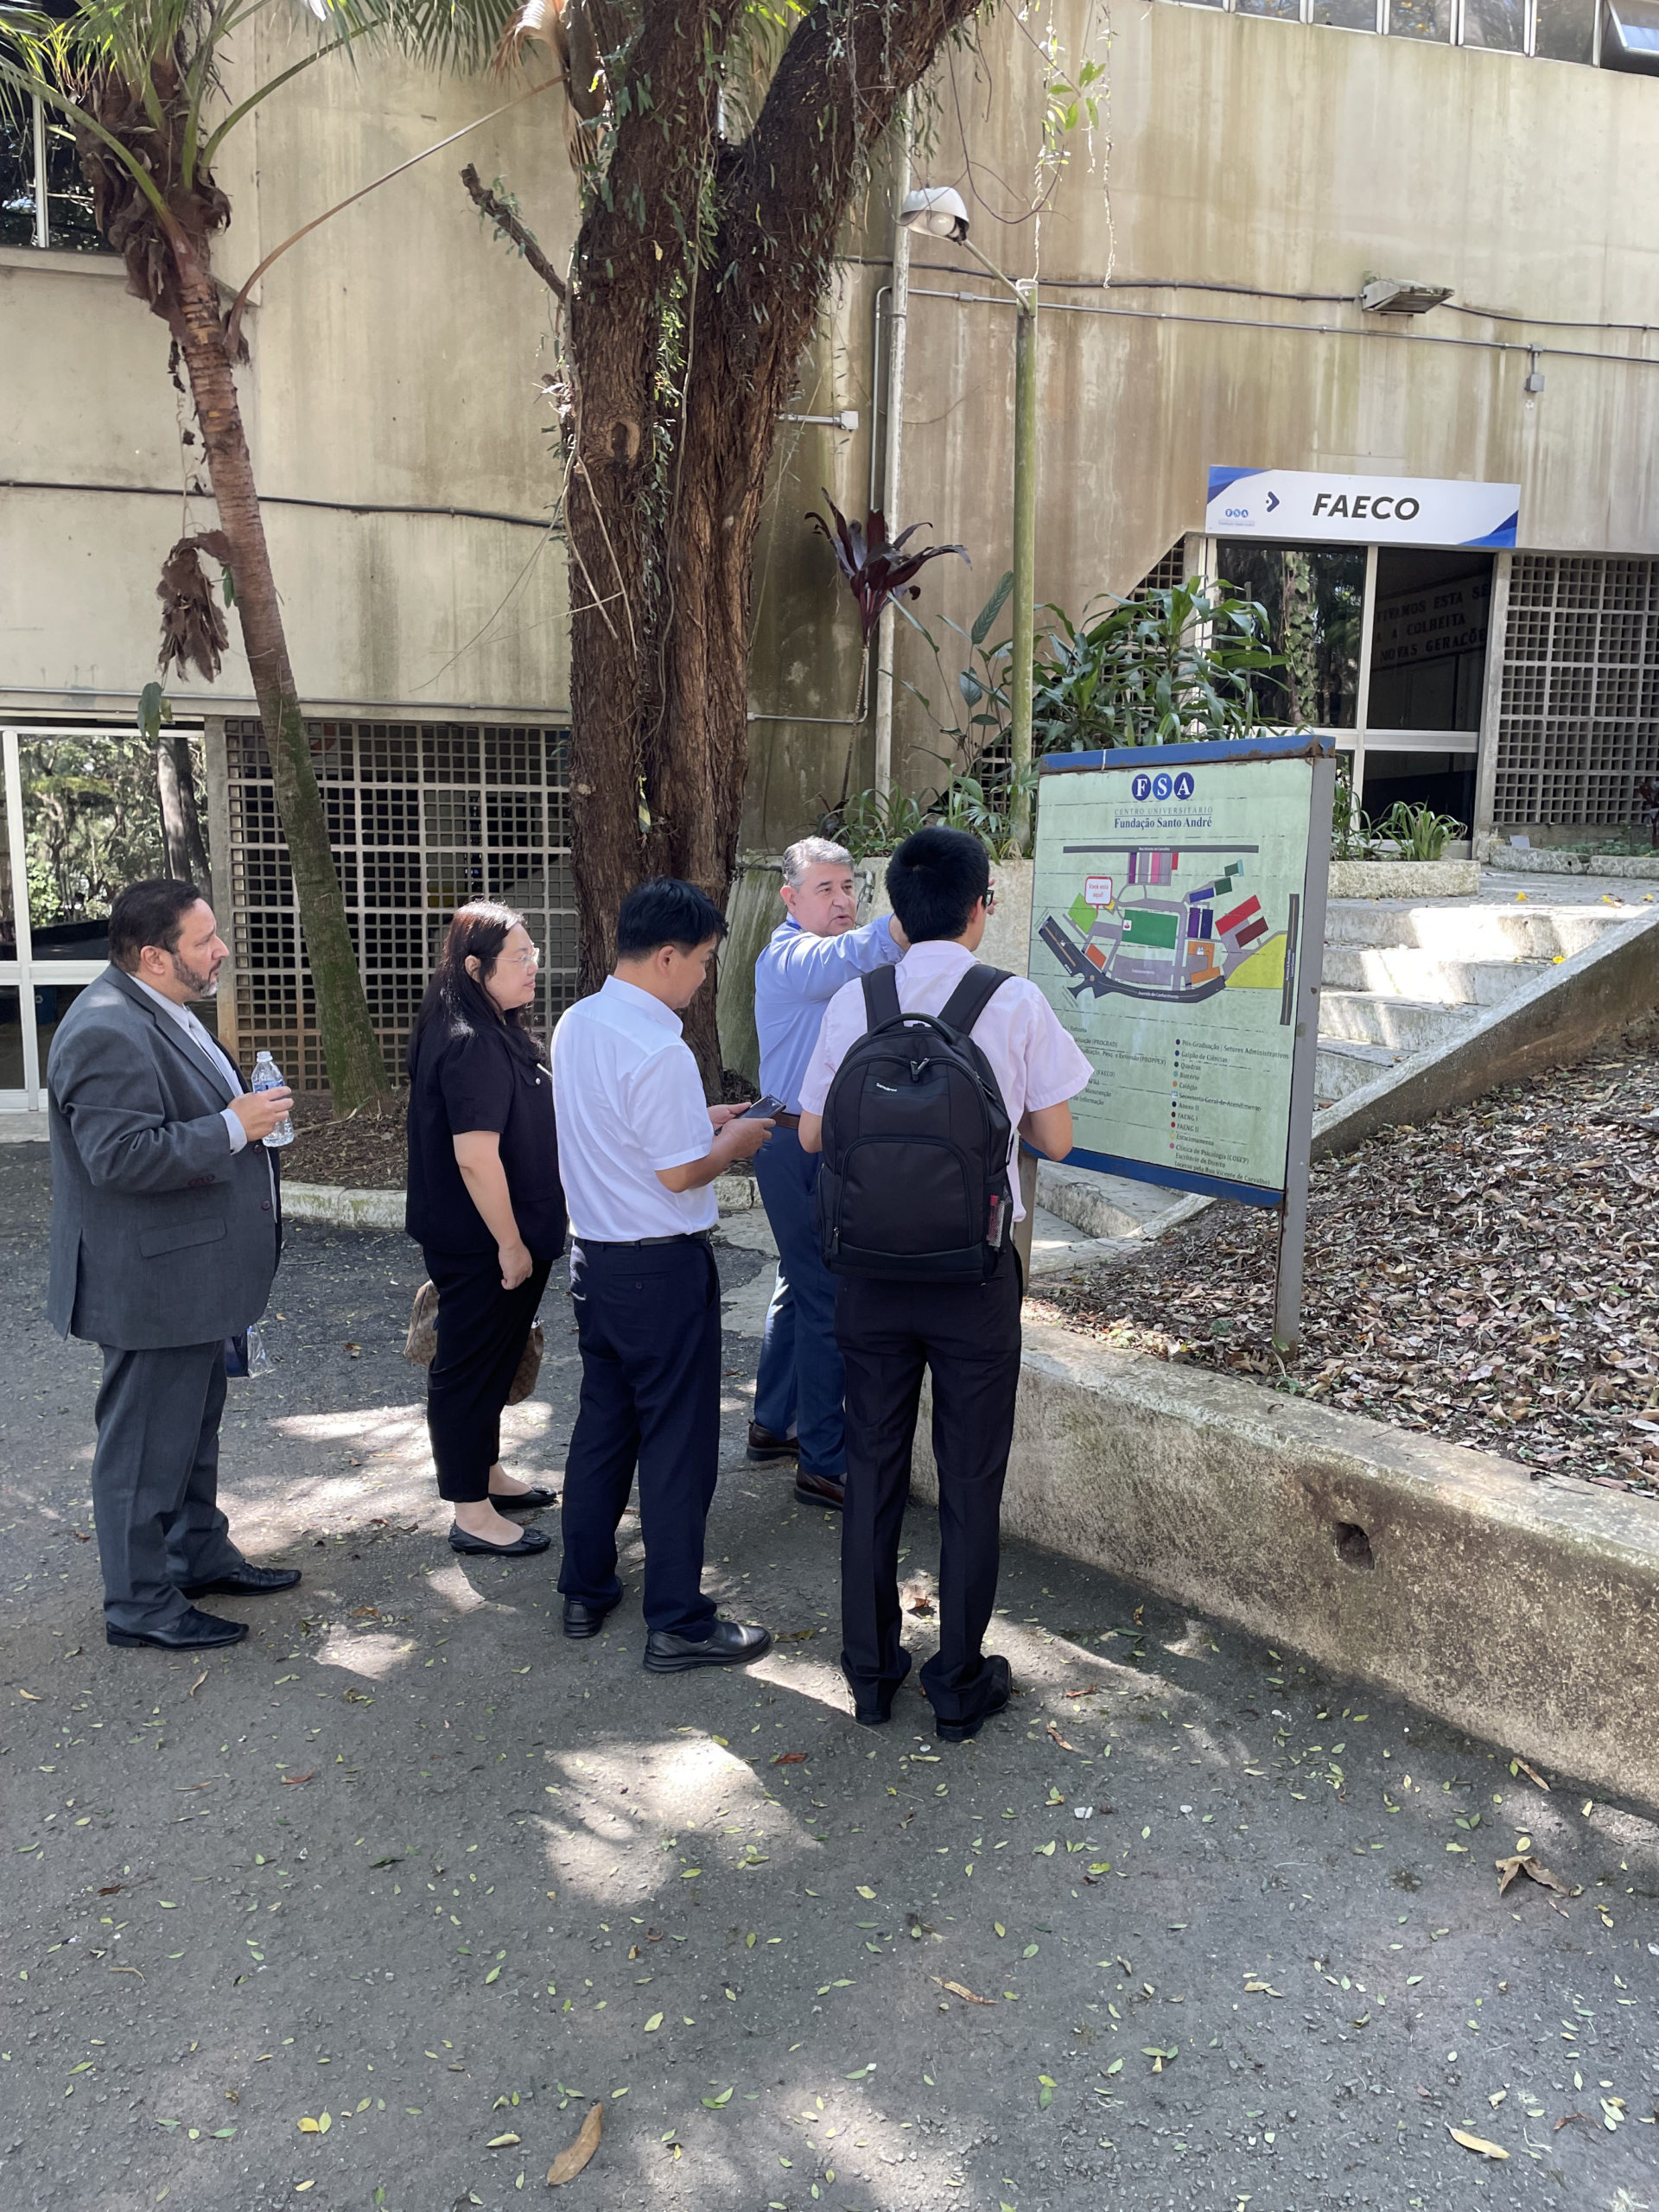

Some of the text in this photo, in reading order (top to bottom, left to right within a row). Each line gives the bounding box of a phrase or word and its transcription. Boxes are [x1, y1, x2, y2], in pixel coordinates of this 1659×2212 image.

[1313, 493, 1420, 521] FAECO
[1376, 601, 1426, 622] TIVAMOS
[1433, 590, 1463, 610] ESTA
[1407, 612, 1466, 636] COLHEITA
[1380, 626, 1487, 661] NOVAS GERAÇÕE
[1135, 776, 1192, 798] FSA
[1148, 806, 1213, 815] UNIVERSITÁRIO
[1114, 816, 1212, 830] Fundação Santo André
[1182, 1039, 1289, 1059] Pós-Graduação Setores Administrativos
[1181, 1051, 1198, 1060] Galpão
[1206, 1054, 1228, 1063] Ciências
[1181, 1062, 1201, 1071] Quadras
[1179, 1082, 1197, 1091] Colégio
[1177, 1112, 1195, 1121] FAENG
[1177, 1122, 1194, 1132] FAENG
[1176, 1133, 1214, 1146] Estacionamento
[1176, 1145, 1193, 1153] Clínica
[1201, 1149, 1226, 1160] Psicologia
[1176, 1153, 1199, 1163] Escritório
[1208, 1159, 1225, 1168] Direito
[1193, 1164, 1204, 1172] pela
[1216, 1169, 1235, 1178] Vicente
[1244, 1175, 1270, 1186] Carvalho)
